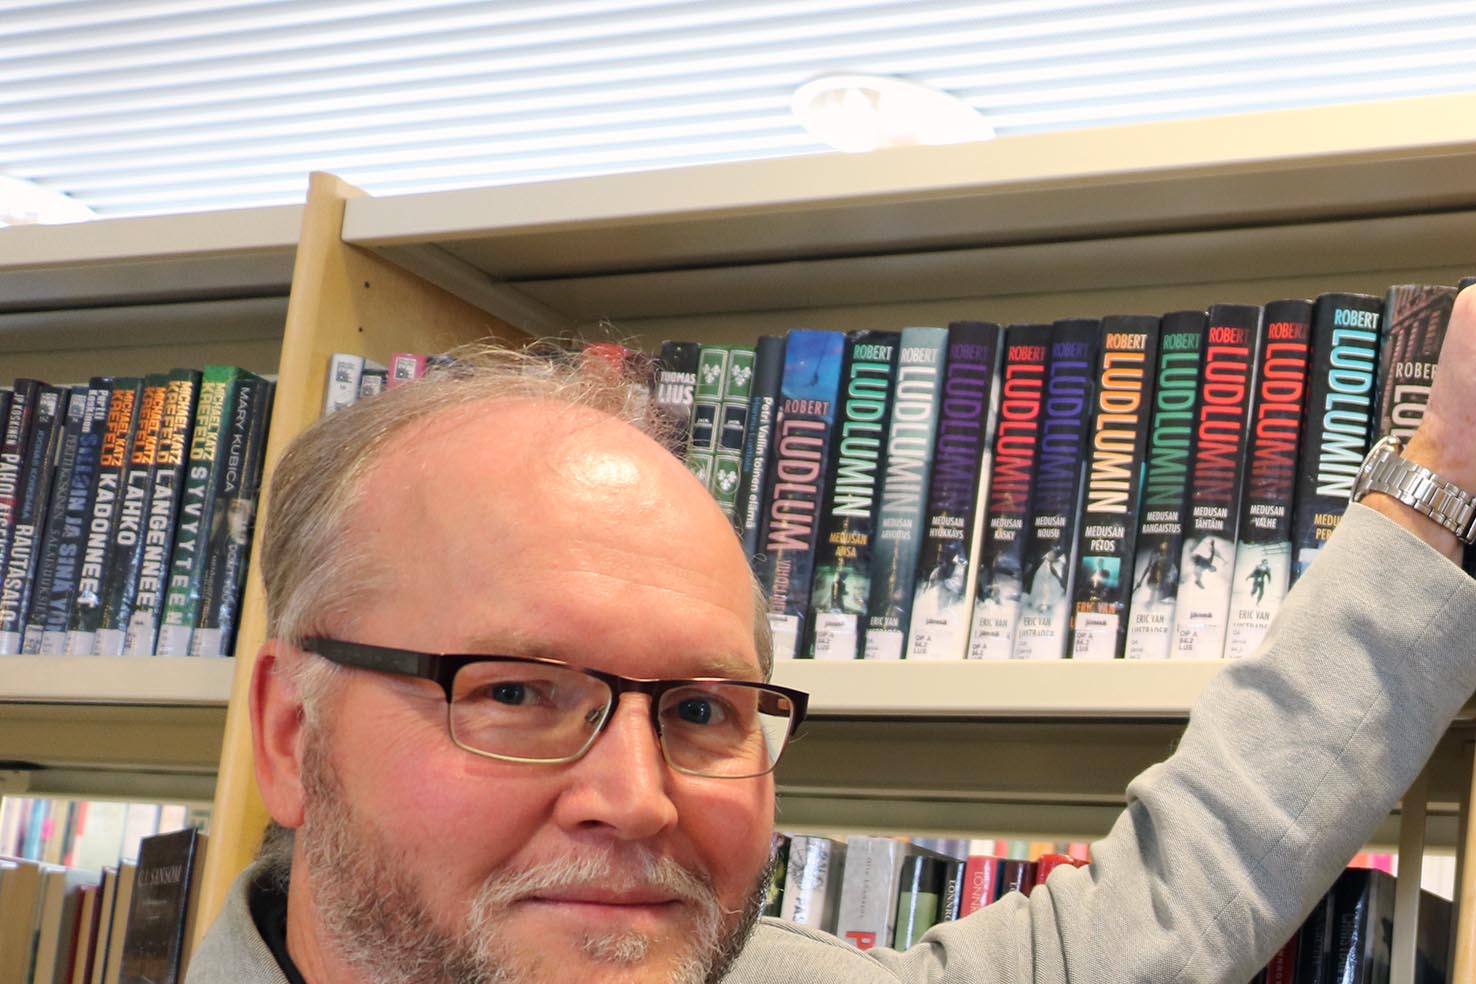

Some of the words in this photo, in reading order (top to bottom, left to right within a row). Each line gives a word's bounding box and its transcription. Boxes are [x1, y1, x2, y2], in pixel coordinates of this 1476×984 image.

[1106, 333, 1147, 350] ROBERT
[1163, 333, 1200, 350] ROBERT
[1208, 327, 1249, 344] ROBERT
[1268, 322, 1307, 339] ROBERT
[1334, 310, 1379, 330] ROBERT
[853, 344, 893, 361] ROBERT
[900, 348, 937, 363] ROBERT
[1008, 345, 1045, 361] ROBERT
[235, 387, 250, 432] MARY
[785, 400, 829, 415] ROBERT
[1145, 353, 1200, 506] LUDLUMIN
[1193, 347, 1249, 502] LUDLUMIN
[1252, 343, 1307, 497] LUDLUMIN
[1316, 329, 1377, 496] LUDLUMIN
[832, 363, 890, 517] LUDLUMIN
[881, 367, 936, 512] LUDLUMIN
[989, 365, 1045, 513] LUDLUMIN
[1087, 353, 1145, 514] LUDLUMIN
[224, 434, 243, 492] KUBICA
[767, 420, 826, 550] LUDLUM
[117, 471, 147, 545] LAHKO
[1085, 526, 1124, 539] MEDUSAN
